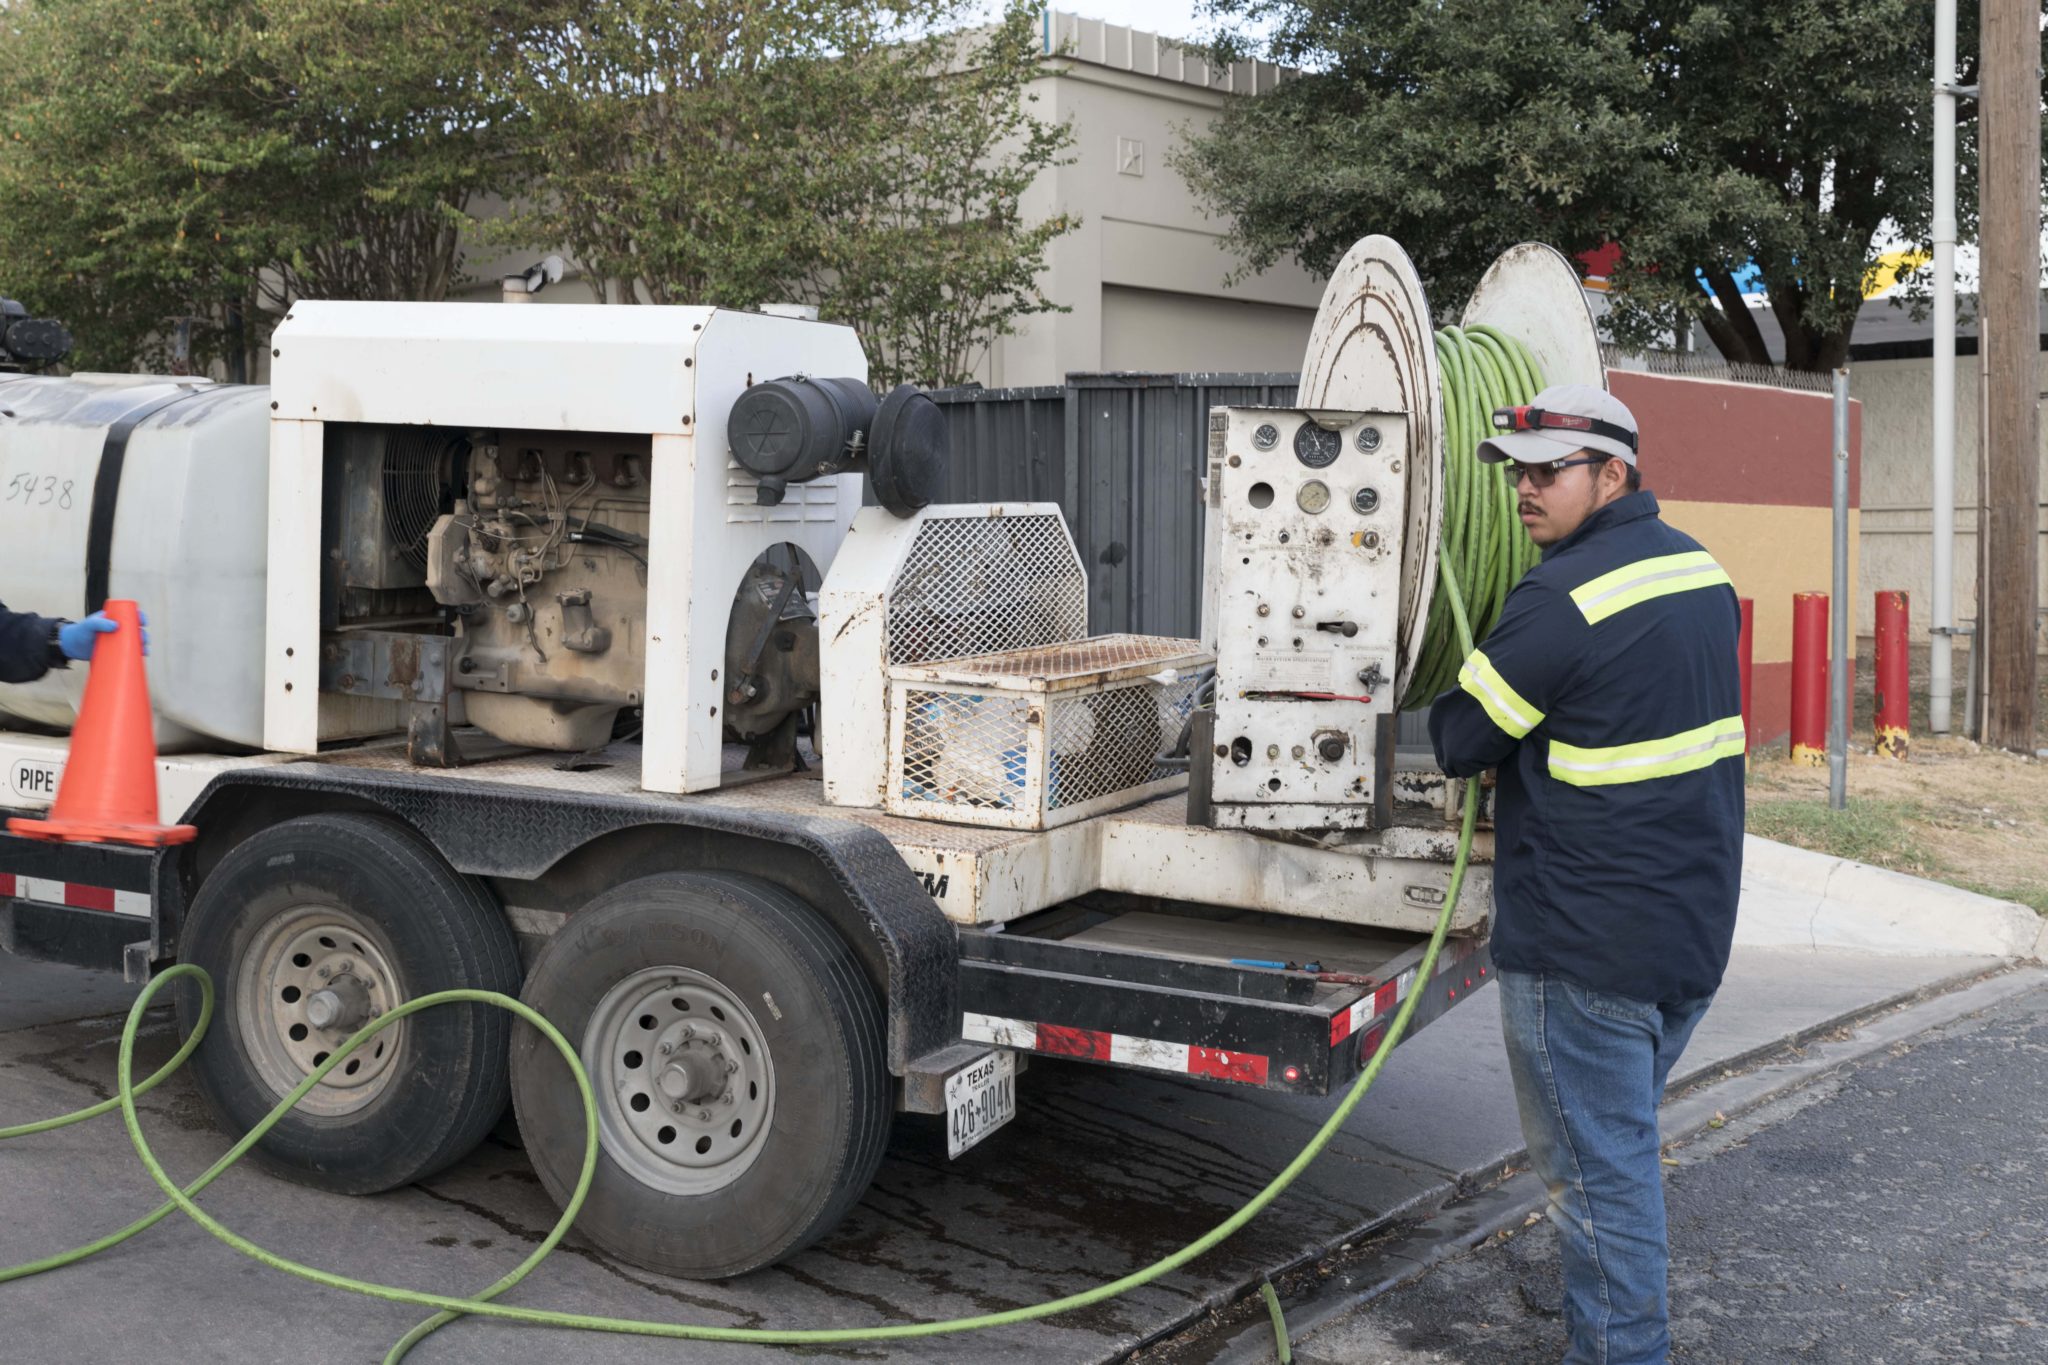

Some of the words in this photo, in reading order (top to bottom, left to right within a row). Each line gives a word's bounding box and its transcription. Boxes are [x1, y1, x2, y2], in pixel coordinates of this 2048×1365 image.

[6, 472, 74, 510] 5438
[20, 768, 53, 792] PIPE
[967, 1060, 994, 1086] TEXAS
